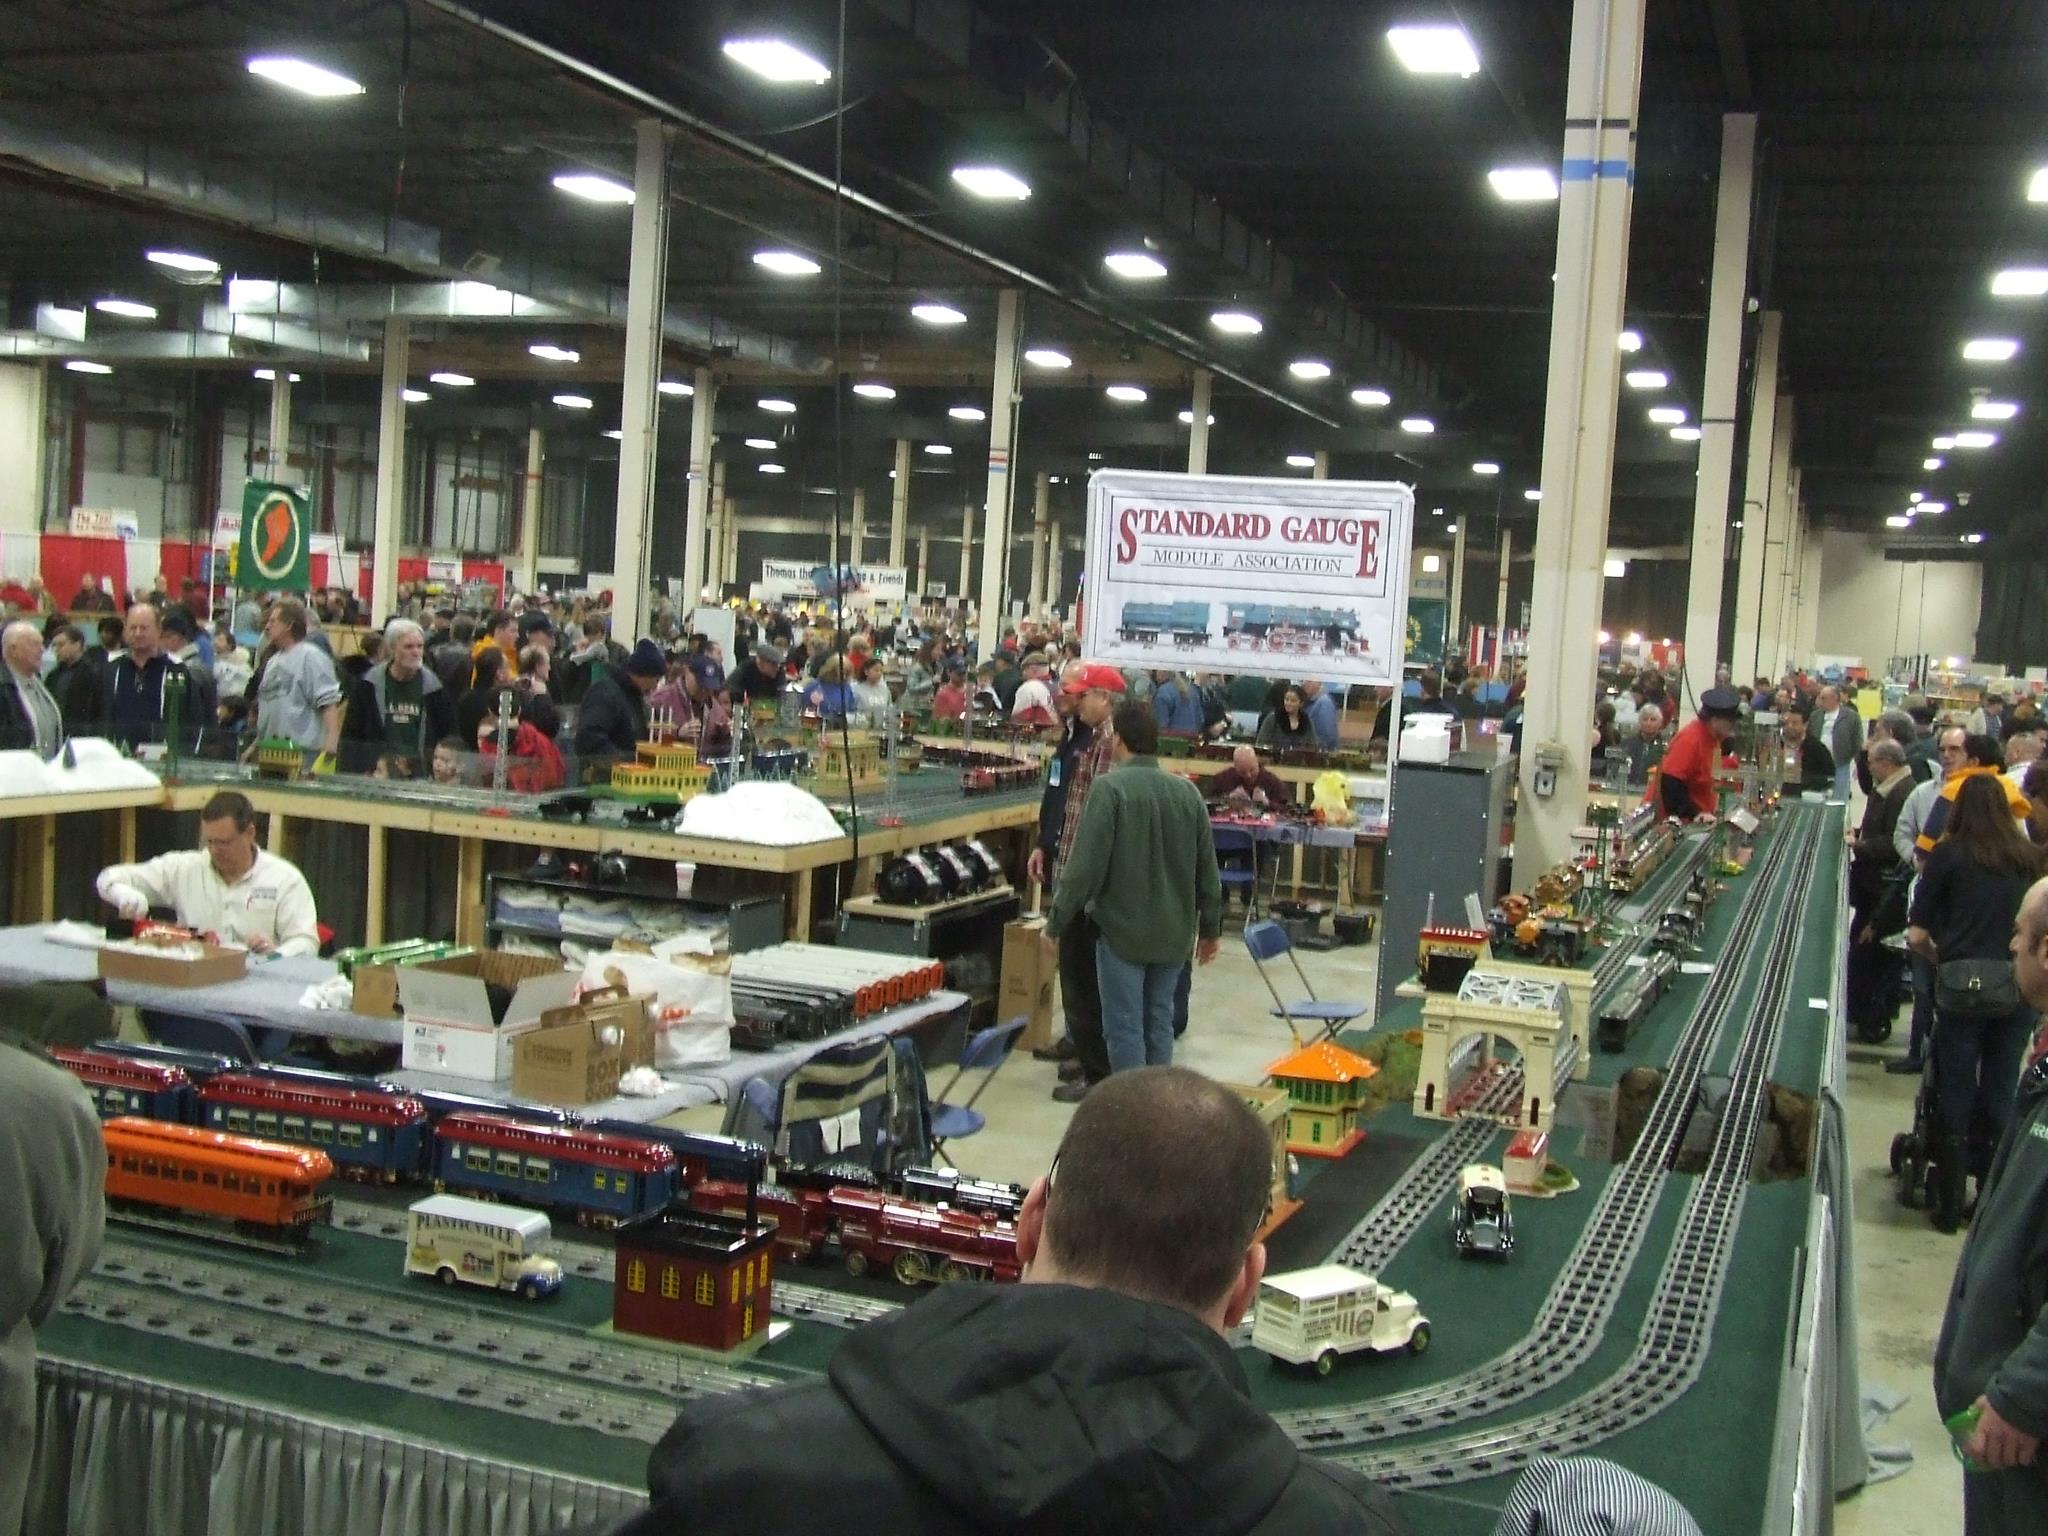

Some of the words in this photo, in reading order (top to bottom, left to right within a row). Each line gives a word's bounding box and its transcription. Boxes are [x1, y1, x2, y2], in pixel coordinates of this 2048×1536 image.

[1117, 508, 1271, 565] STANDARD
[1281, 516, 1380, 579] GAUGE
[1153, 549, 1223, 567] MODULE
[1233, 553, 1342, 572] ASSOCIATION
[765, 564, 796, 579] Thomas
[878, 572, 904, 585] Friends
